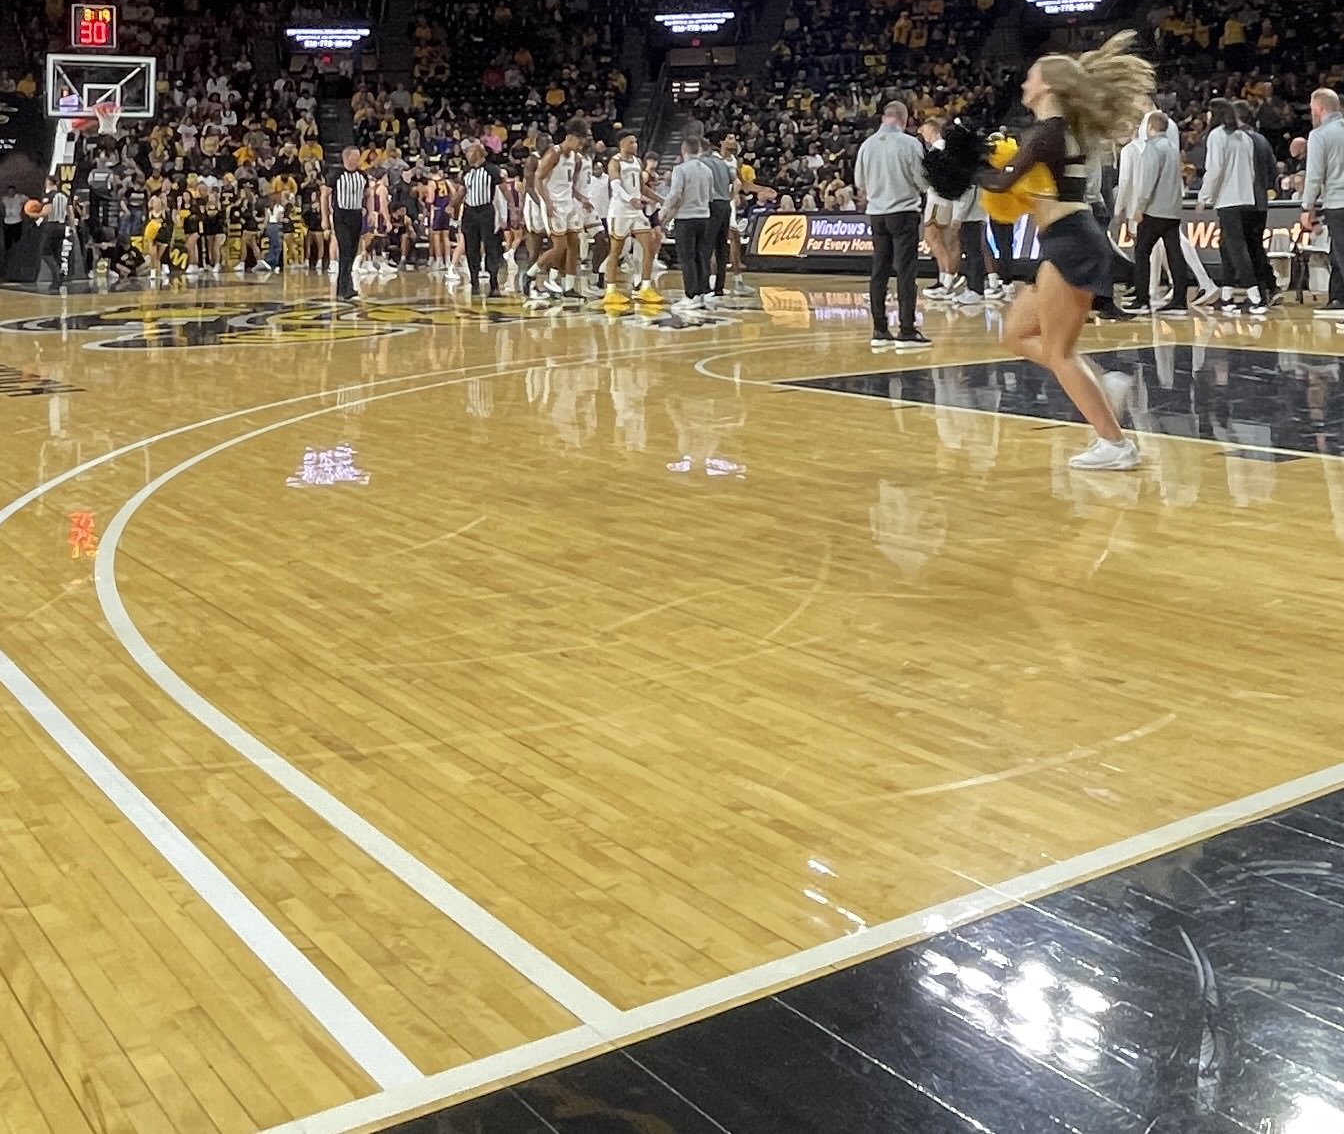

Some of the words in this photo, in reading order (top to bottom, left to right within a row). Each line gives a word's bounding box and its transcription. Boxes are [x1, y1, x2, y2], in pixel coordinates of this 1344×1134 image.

[80, 20, 107, 44] 30
[762, 217, 805, 252] Pella
[810, 219, 865, 236] Windows
[806, 238, 822, 251] For
[823, 238, 851, 253] Every
[851, 238, 874, 251] Hom
